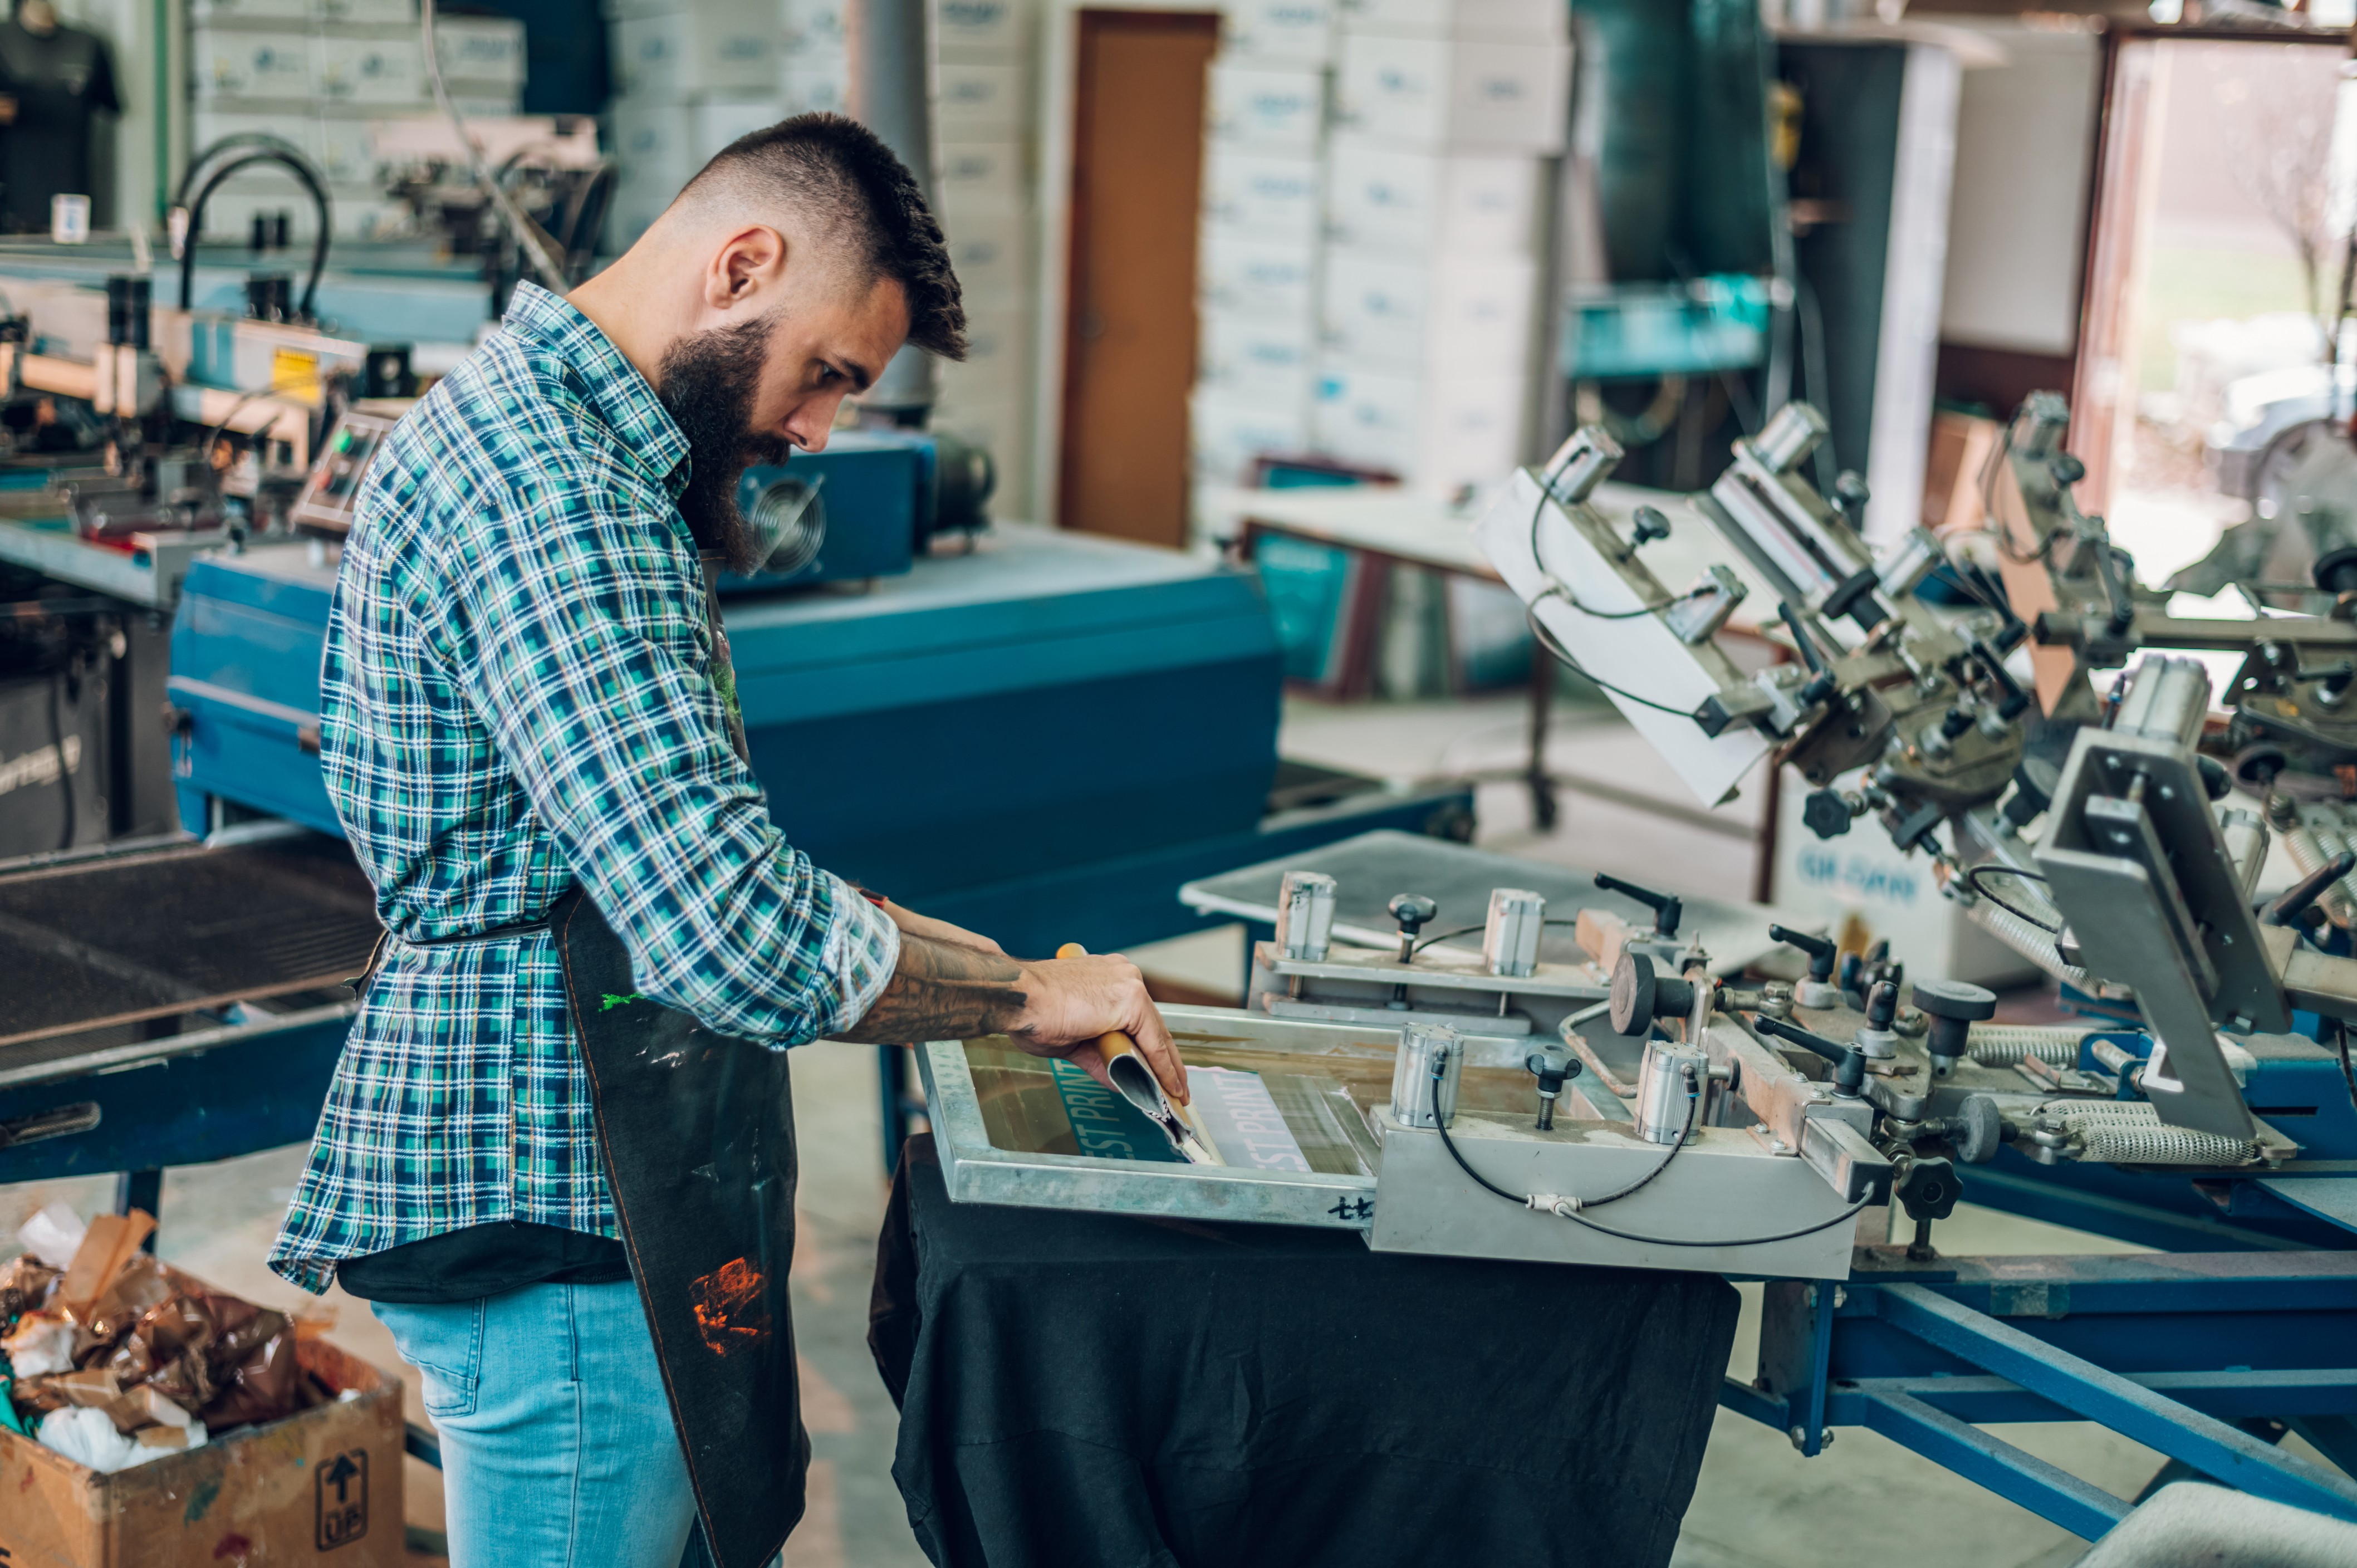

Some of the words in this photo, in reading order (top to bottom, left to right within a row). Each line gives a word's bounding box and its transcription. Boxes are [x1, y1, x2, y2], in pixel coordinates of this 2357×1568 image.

[1053, 1059, 1119, 1121] PRINT
[1212, 1073, 1286, 1134] PRINT
[325, 1505, 361, 1542] UP
